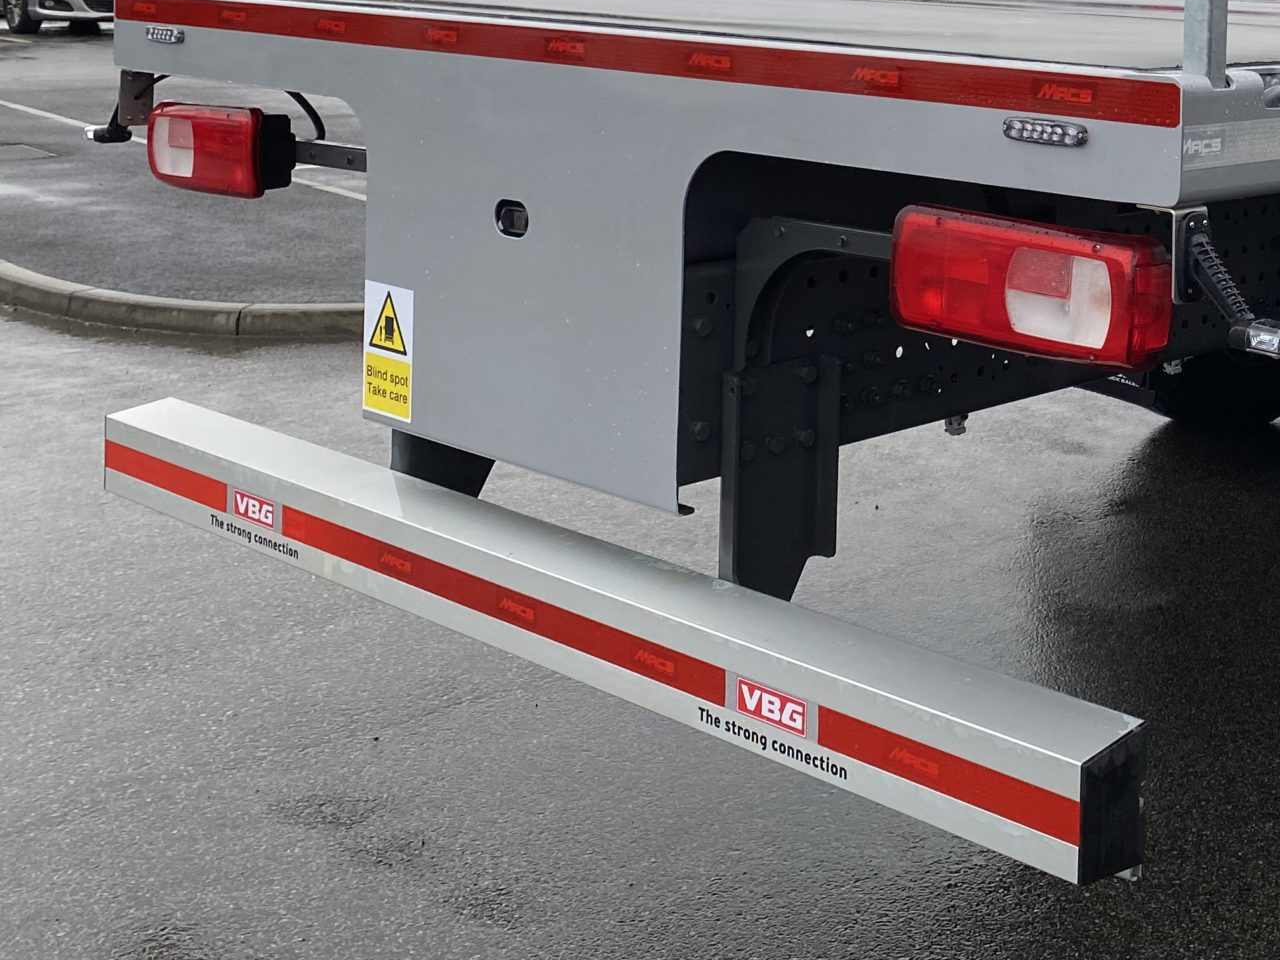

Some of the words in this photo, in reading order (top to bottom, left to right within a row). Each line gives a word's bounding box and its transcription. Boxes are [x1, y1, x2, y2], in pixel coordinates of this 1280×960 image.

[367, 365, 388, 381] Blind
[390, 374, 408, 387] spot
[367, 382, 387, 398] Take
[389, 391, 407, 404] care
[235, 493, 274, 525] VBG
[210, 514, 224, 531] The
[226, 520, 252, 543] strong
[253, 532, 299, 560] connection
[741, 684, 804, 729] VBG
[698, 706, 721, 729] The
[724, 719, 768, 750] strong
[771, 737, 848, 780] connection
